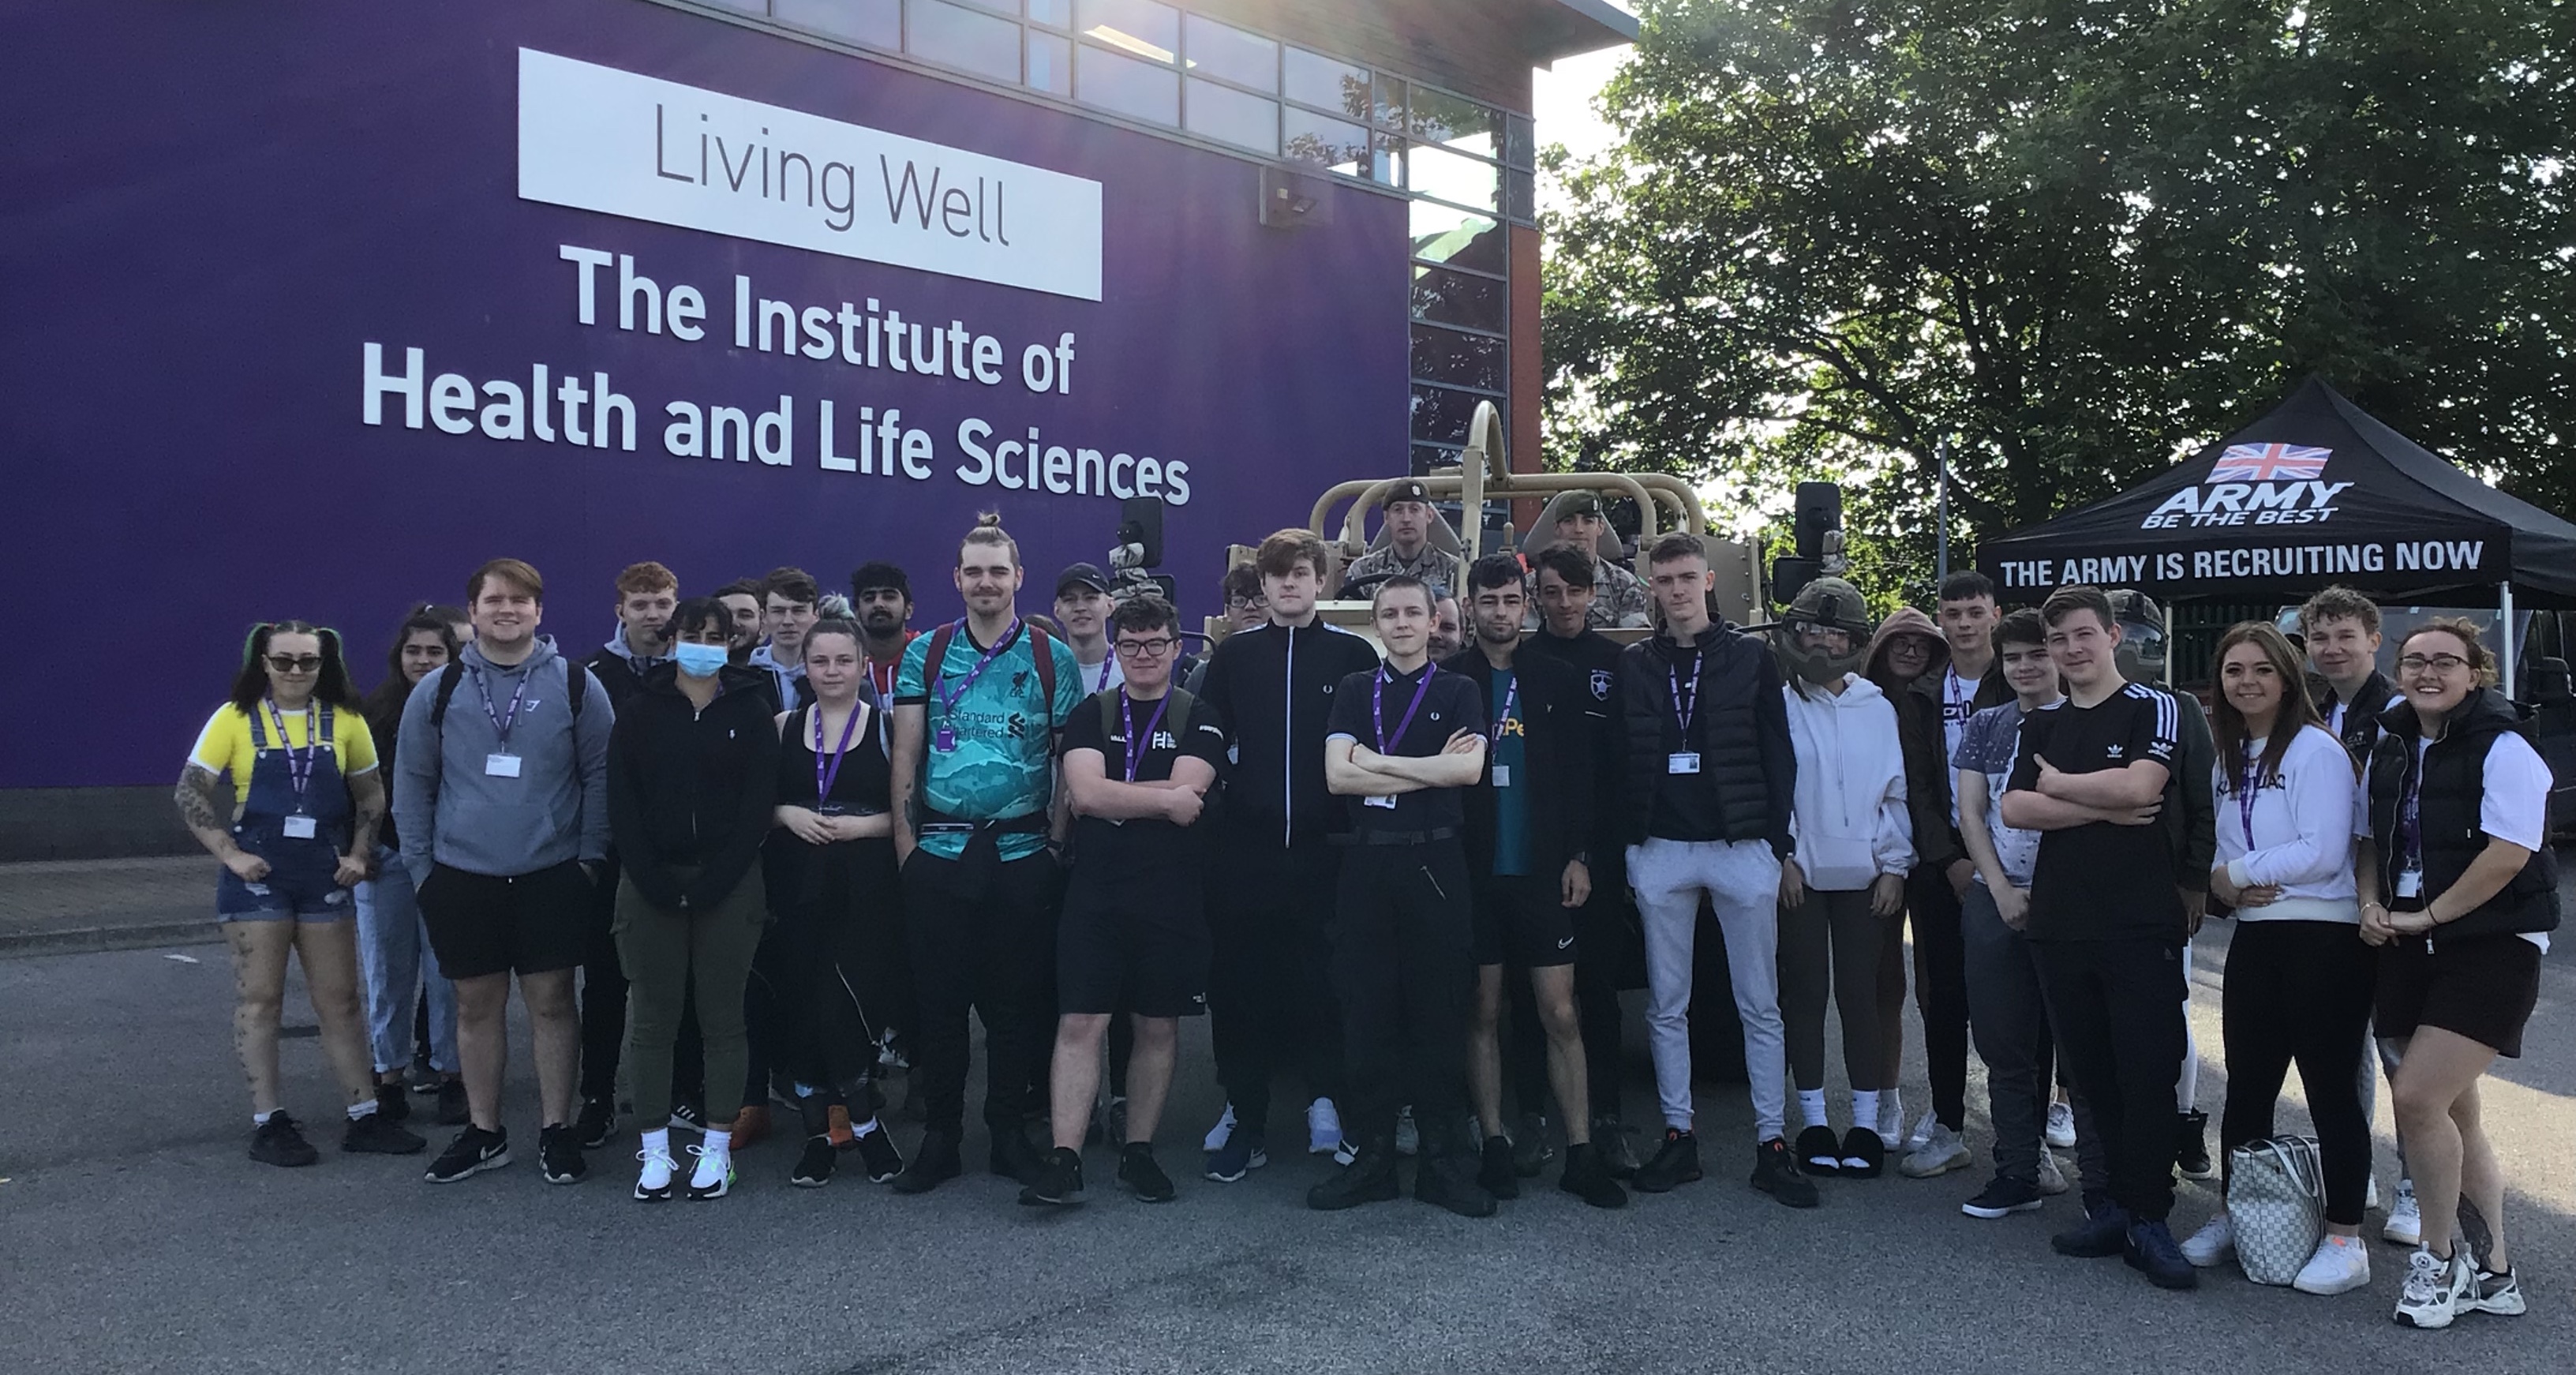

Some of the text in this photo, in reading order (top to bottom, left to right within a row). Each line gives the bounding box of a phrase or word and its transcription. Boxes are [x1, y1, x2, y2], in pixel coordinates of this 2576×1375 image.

[657, 103, 1009, 247] Living Well
[560, 244, 1075, 395] The Institute of
[362, 342, 1190, 506] Health and Life Sciences
[2151, 480, 2355, 515] ARMY
[2140, 508, 2339, 530] BE THE BEST
[1999, 541, 2484, 586] THE ARMY IS RECRUITING NOW
[949, 709, 1005, 724] Standard
[953, 726, 1004, 738] hartered
